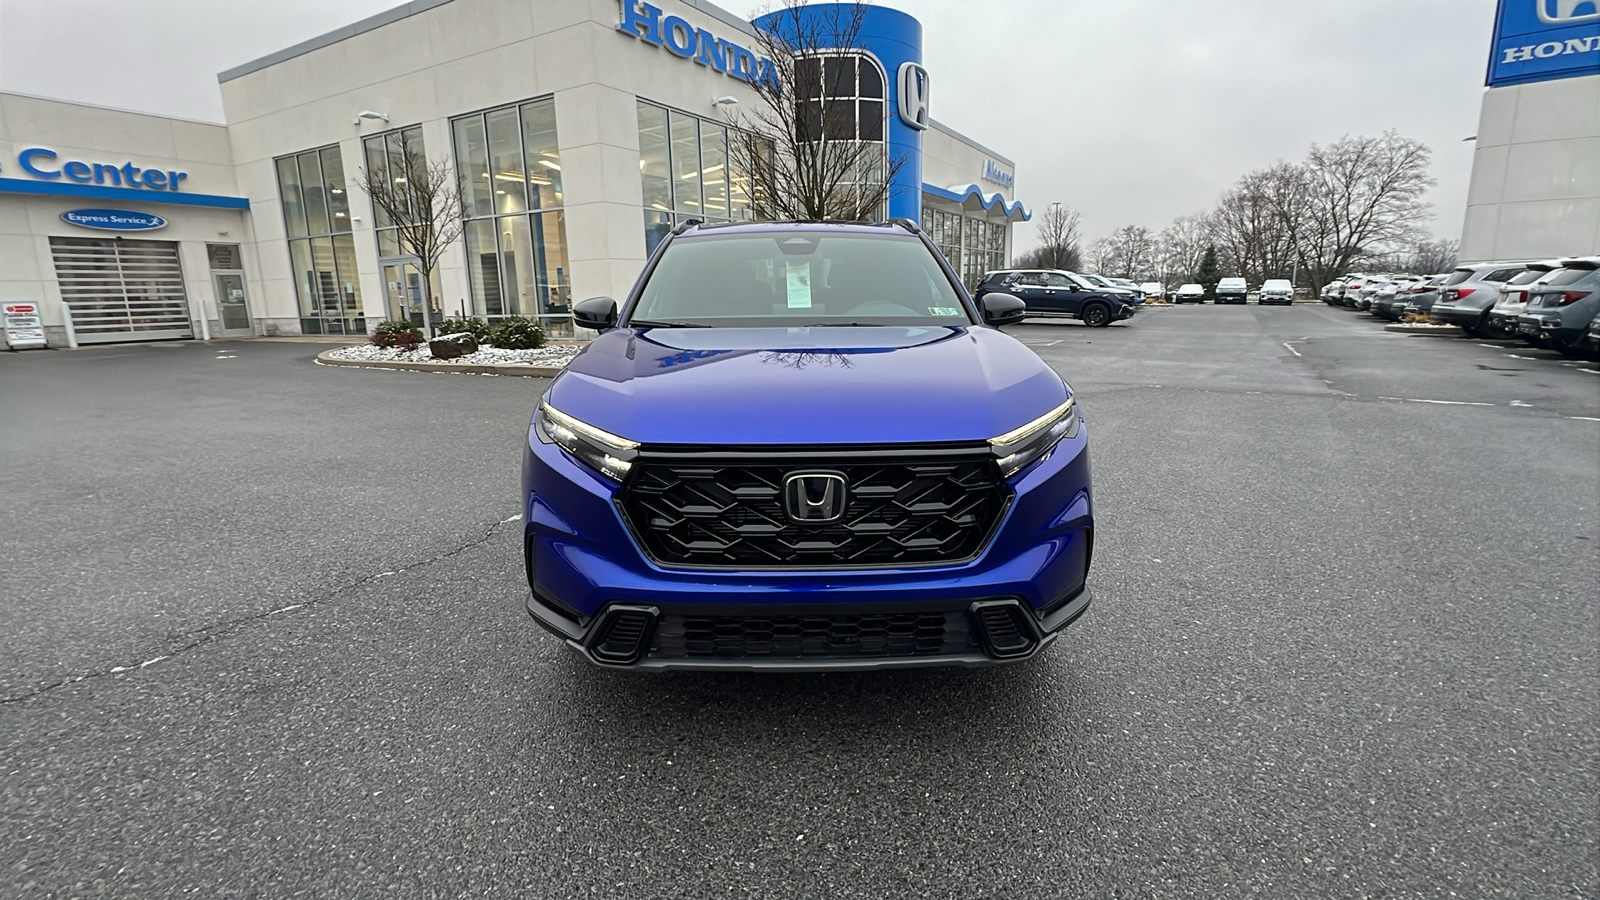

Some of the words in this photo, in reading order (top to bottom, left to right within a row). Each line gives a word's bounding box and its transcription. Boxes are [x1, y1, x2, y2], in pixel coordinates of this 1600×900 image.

[618, 0, 783, 94] HONDA
[1501, 35, 1600, 64] HON
[18, 147, 188, 191] Center
[68, 213, 109, 223] Express
[110, 215, 147, 224] Service
